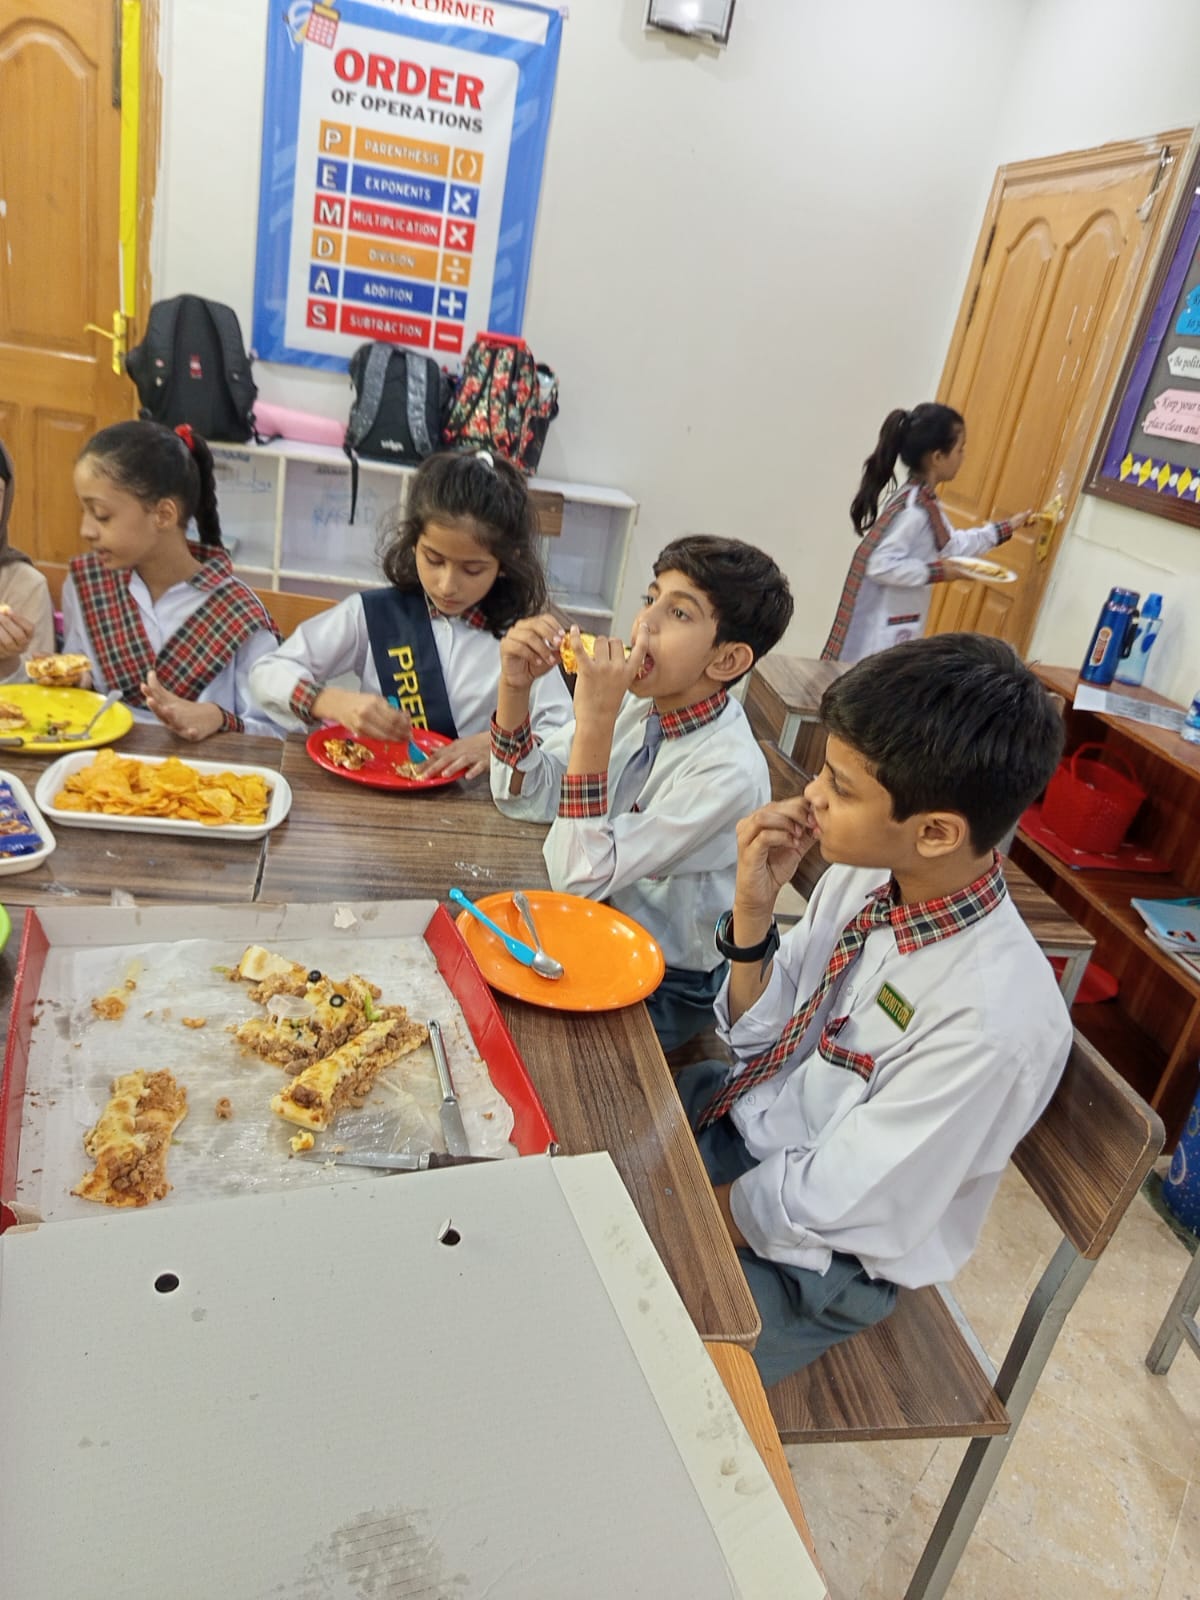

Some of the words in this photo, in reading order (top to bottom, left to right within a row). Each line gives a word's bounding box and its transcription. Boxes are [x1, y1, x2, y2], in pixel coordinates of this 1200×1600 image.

[334, 47, 484, 110] ORDER
[331, 88, 357, 106] OF
[361, 94, 483, 134] OPERATIONS
[323, 127, 342, 151] P
[364, 138, 440, 167] PARENTHESIS
[322, 163, 338, 190] E
[364, 174, 432, 202] EXPONENTS
[318, 199, 342, 226] M
[352, 208, 439, 239] MULTIPLICATION
[316, 235, 335, 258] D
[368, 248, 416, 268] DIVISION
[314, 269, 332, 294] A
[362, 281, 413, 303] ADDITION
[311, 303, 328, 326] S
[349, 313, 423, 339] SUBTRACTION
[879, 987, 910, 1026] MONITOR
